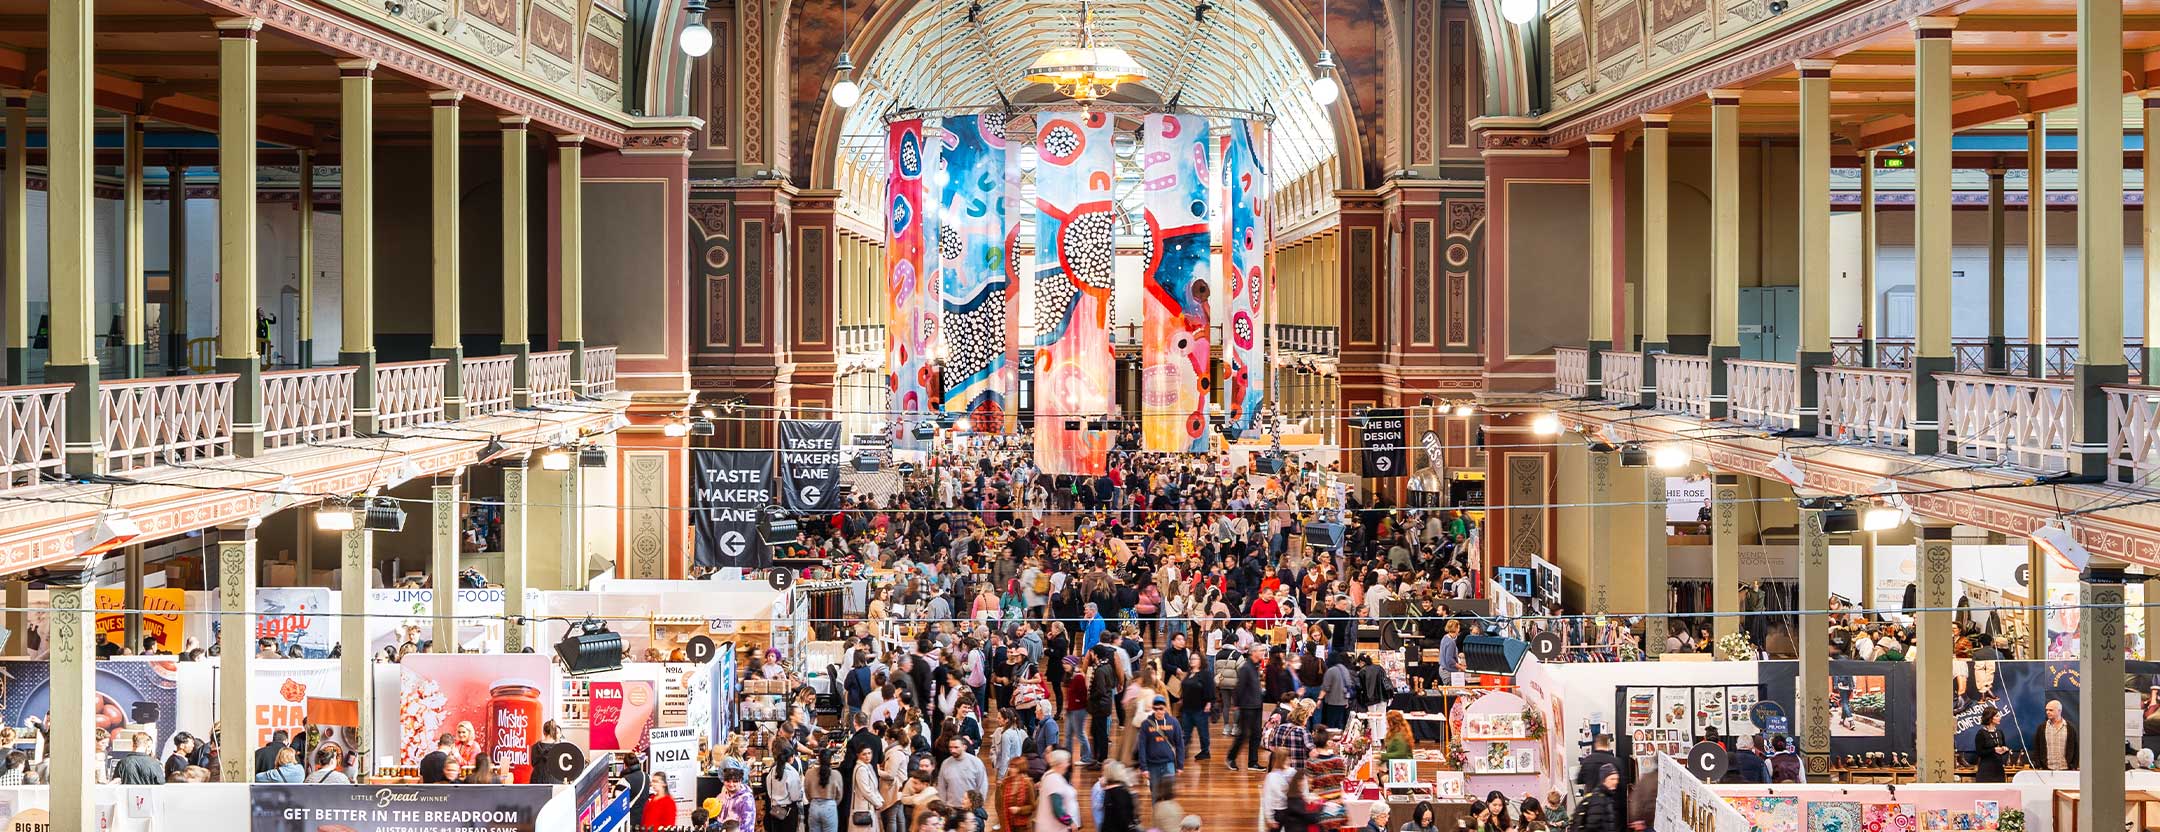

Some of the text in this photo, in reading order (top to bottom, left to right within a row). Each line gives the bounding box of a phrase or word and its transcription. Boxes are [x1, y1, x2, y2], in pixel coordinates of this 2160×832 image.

[1384, 420, 1402, 429] BIG
[1363, 431, 1402, 441] DESIGN
[789, 438, 833, 449] TASTE
[1372, 443, 1394, 452] BAR
[1422, 433, 1442, 461] PIES
[783, 453, 839, 464] MAKERS
[706, 469, 761, 483] TASTE
[793, 468, 829, 479] LANE
[698, 488, 770, 503] MAKERS
[1666, 489, 1705, 497] HIE ROSE
[710, 508, 758, 522] LANE
[776, 573, 785, 585] E
[393, 590, 433, 602] JIMO
[256, 604, 311, 644] ippi
[695, 643, 707, 657] D
[1541, 639, 1553, 654] D
[255, 704, 305, 728] CHA
[497, 708, 529, 736] Misty's
[497, 728, 527, 749] Salted
[651, 728, 695, 739] SCAN TO WIN!
[493, 744, 530, 767] Caramel
[558, 752, 573, 771] C
[1700, 752, 1716, 771] C
[375, 787, 419, 808] Bread
[283, 808, 518, 823] GET BETTER IN THE BREADROOM
[15, 822, 50, 832] BIG BIT
